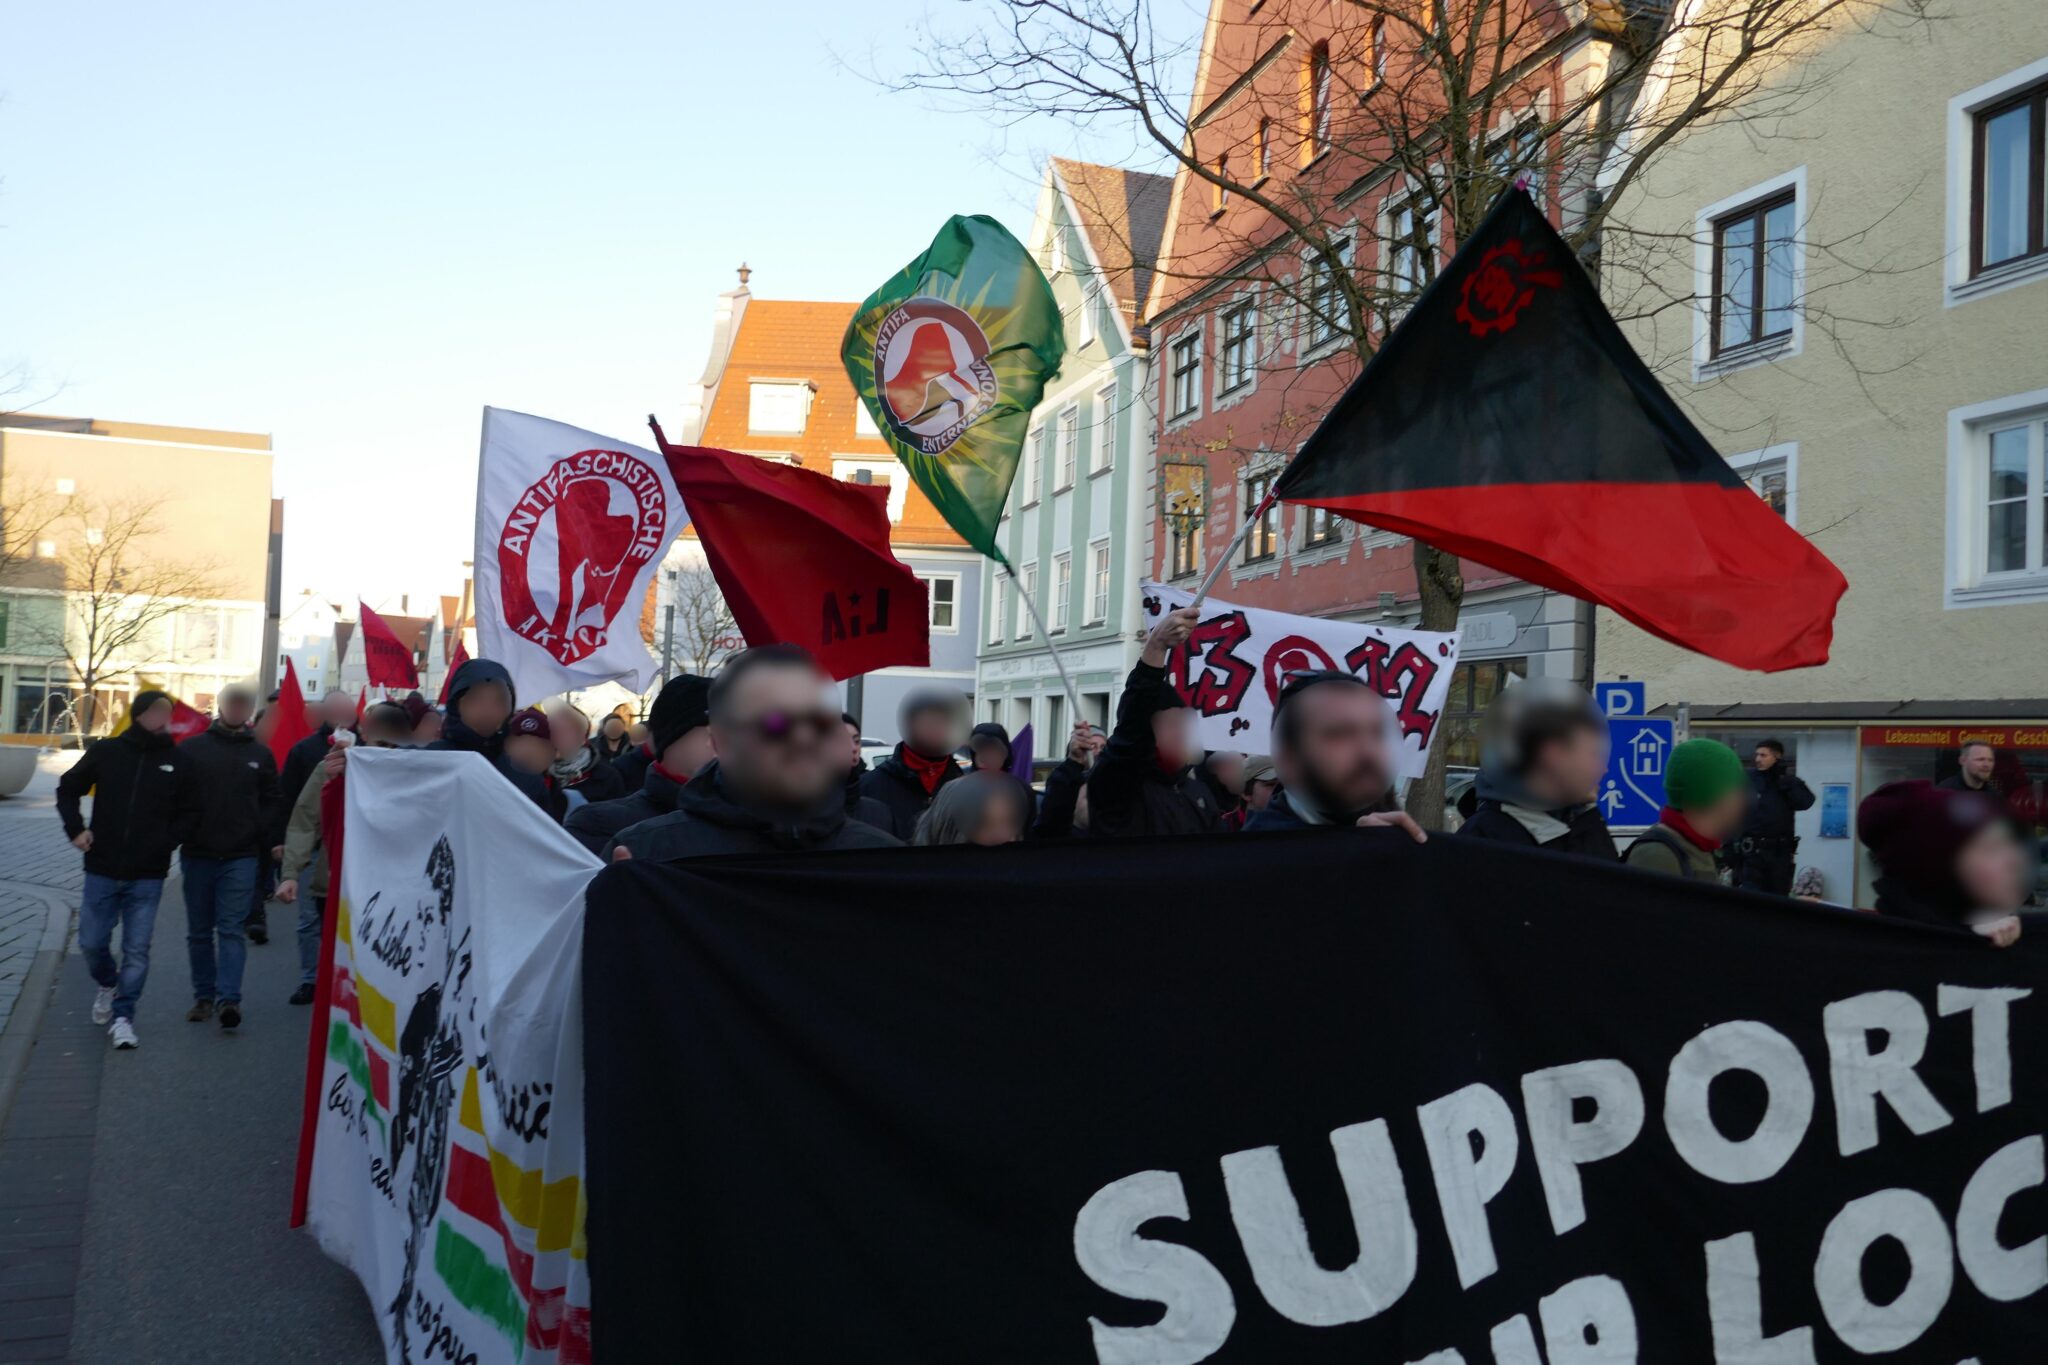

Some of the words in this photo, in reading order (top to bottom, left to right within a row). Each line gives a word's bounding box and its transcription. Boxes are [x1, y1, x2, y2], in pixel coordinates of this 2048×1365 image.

[877, 307, 911, 362] ANTIFA
[921, 357, 995, 453] ENTERNASYONA
[503, 453, 664, 560] ANTIFASCHISTISCHE
[1461, 621, 1497, 643] TADL
[1607, 689, 1634, 715] P
[1885, 729, 1950, 744] Lebensmittel
[1073, 984, 2032, 1365] SUPPORT
